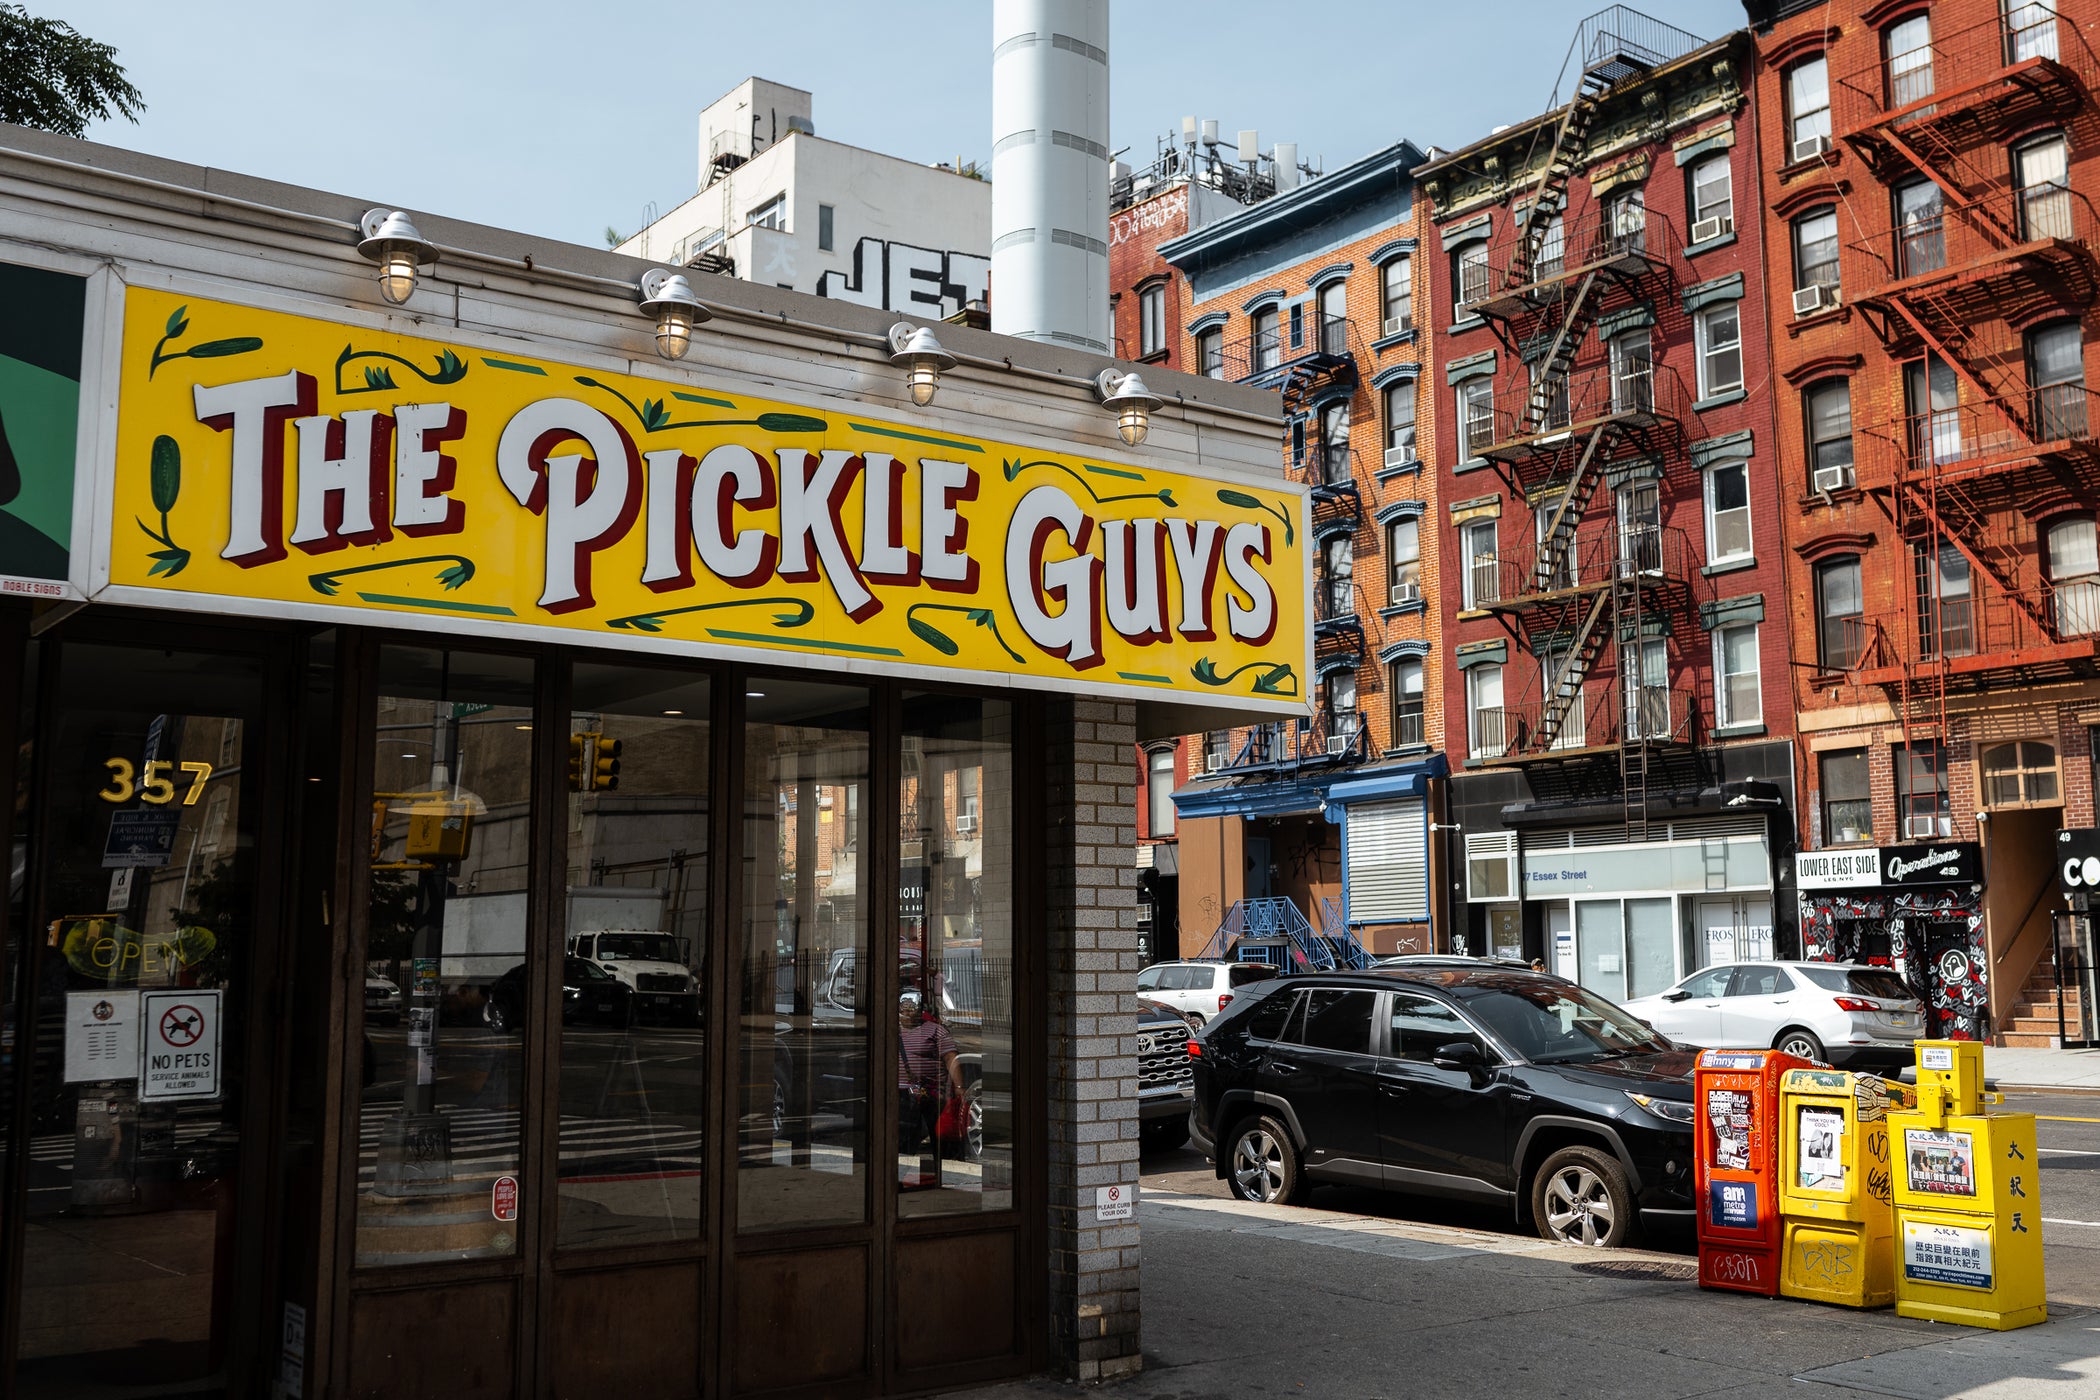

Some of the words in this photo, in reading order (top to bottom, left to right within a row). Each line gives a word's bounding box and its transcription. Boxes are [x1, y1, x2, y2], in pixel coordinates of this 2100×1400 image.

[193, 368, 467, 569] THE
[497, 397, 980, 624] PICKLE
[1006, 485, 1278, 671] GUYS
[98, 757, 214, 806] 357
[2060, 832, 2071, 842] 49
[1800, 859, 1829, 877] LOWER
[1831, 856, 1853, 875] EAST
[1856, 855, 1877, 874] SIDE
[1888, 849, 1962, 882] Operations
[1533, 872, 1558, 881] Essex
[1561, 870, 1587, 880] Street
[92, 937, 187, 973] OPEN
[152, 1055, 170, 1070] NO
[175, 1053, 210, 1069] PETS
[151, 1073, 180, 1082] SERVICE
[181, 1071, 210, 1080] ANIMALS
[164, 1081, 196, 1089] ALLOWED
[1723, 1186, 1745, 1202] am
[2007, 1140, 2028, 1234] 大紀元
[1097, 1203, 1116, 1211] PLEASE
[1915, 1252, 1981, 1269] 指路真相大紀元
